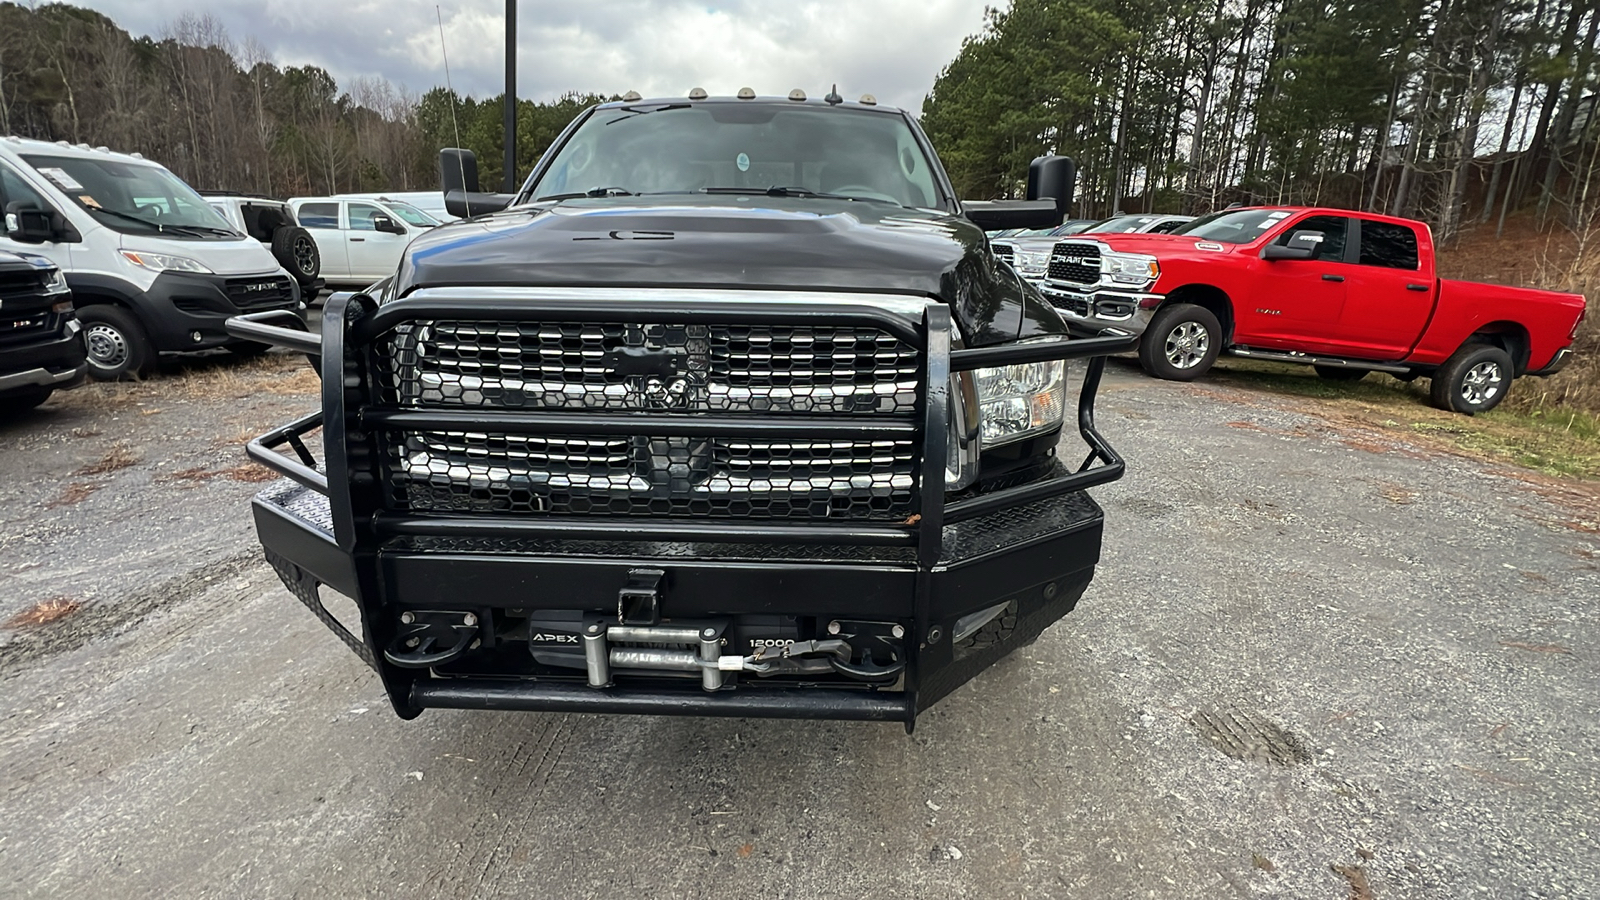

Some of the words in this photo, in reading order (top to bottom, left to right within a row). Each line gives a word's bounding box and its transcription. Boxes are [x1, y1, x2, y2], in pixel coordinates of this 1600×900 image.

[1058, 255, 1082, 264] RAM
[246, 283, 278, 291] RAM
[533, 633, 578, 643] APEX
